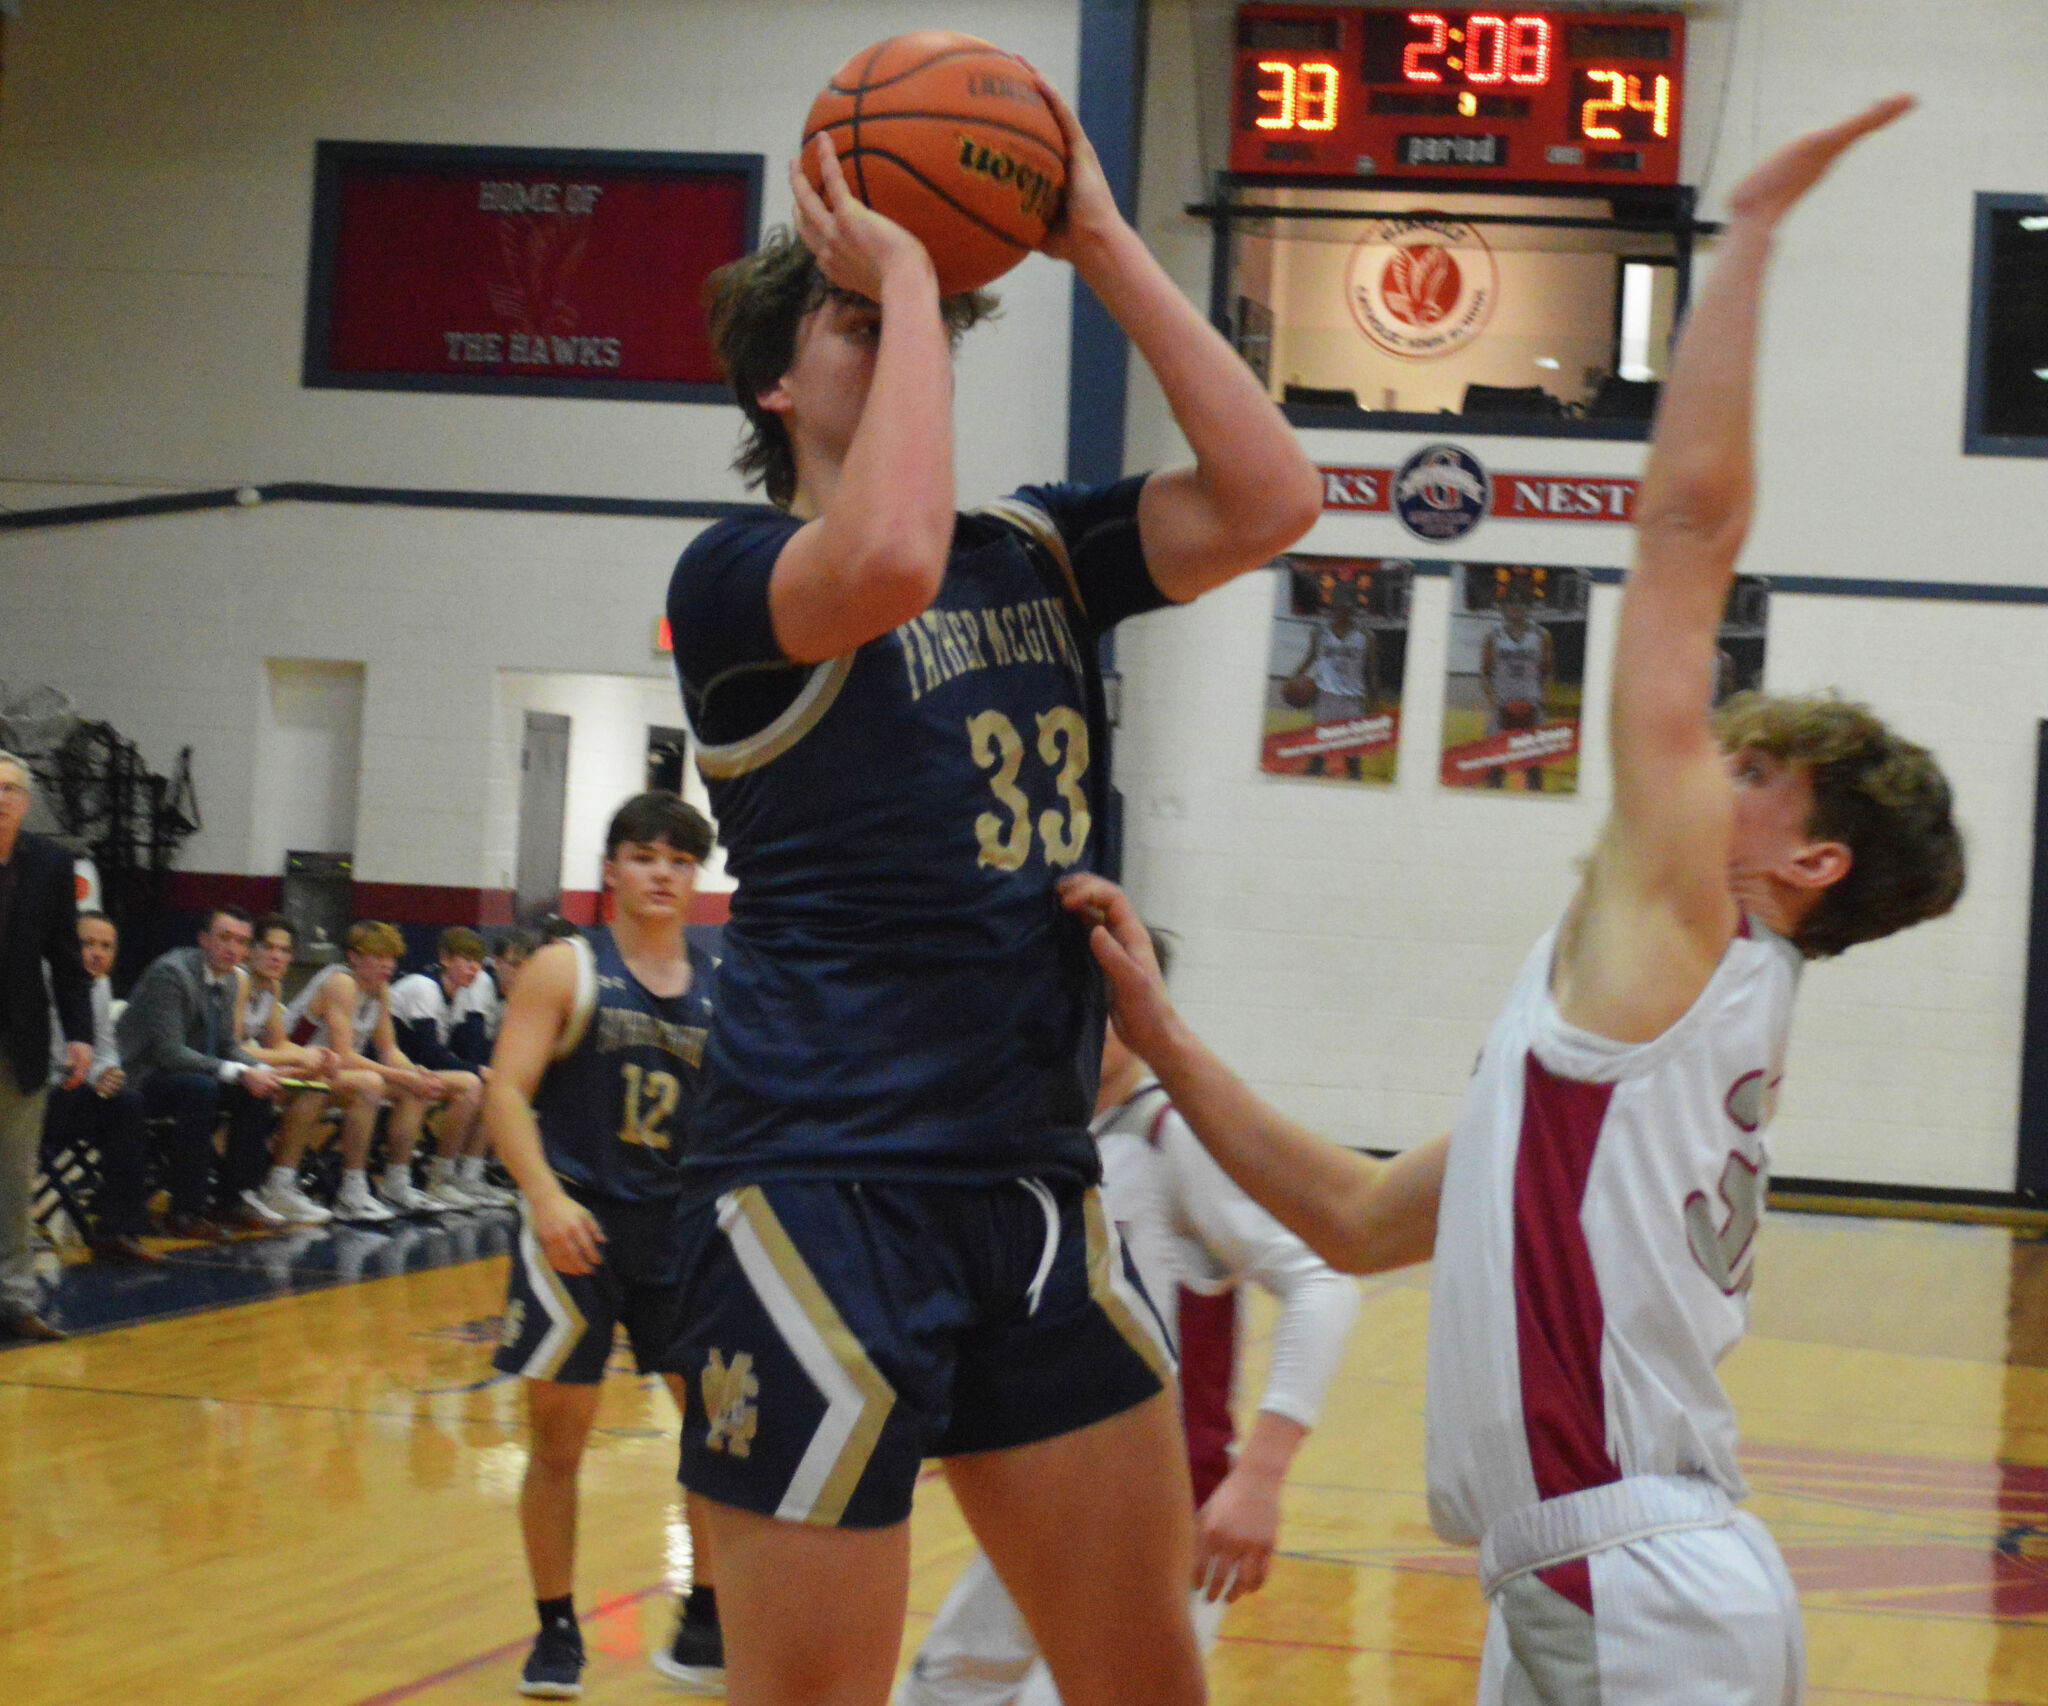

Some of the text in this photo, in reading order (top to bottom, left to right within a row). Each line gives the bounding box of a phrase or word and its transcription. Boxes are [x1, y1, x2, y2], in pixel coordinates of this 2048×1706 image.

[1403, 13, 1552, 85] 2:08
[1582, 70, 1670, 138] 24
[1408, 133, 1496, 167] period
[478, 181, 604, 215] HOME OF
[444, 331, 622, 369] THE HAWKS
[1513, 480, 1636, 516] NEST
[965, 705, 1091, 872] 33
[620, 1061, 681, 1150] 12
